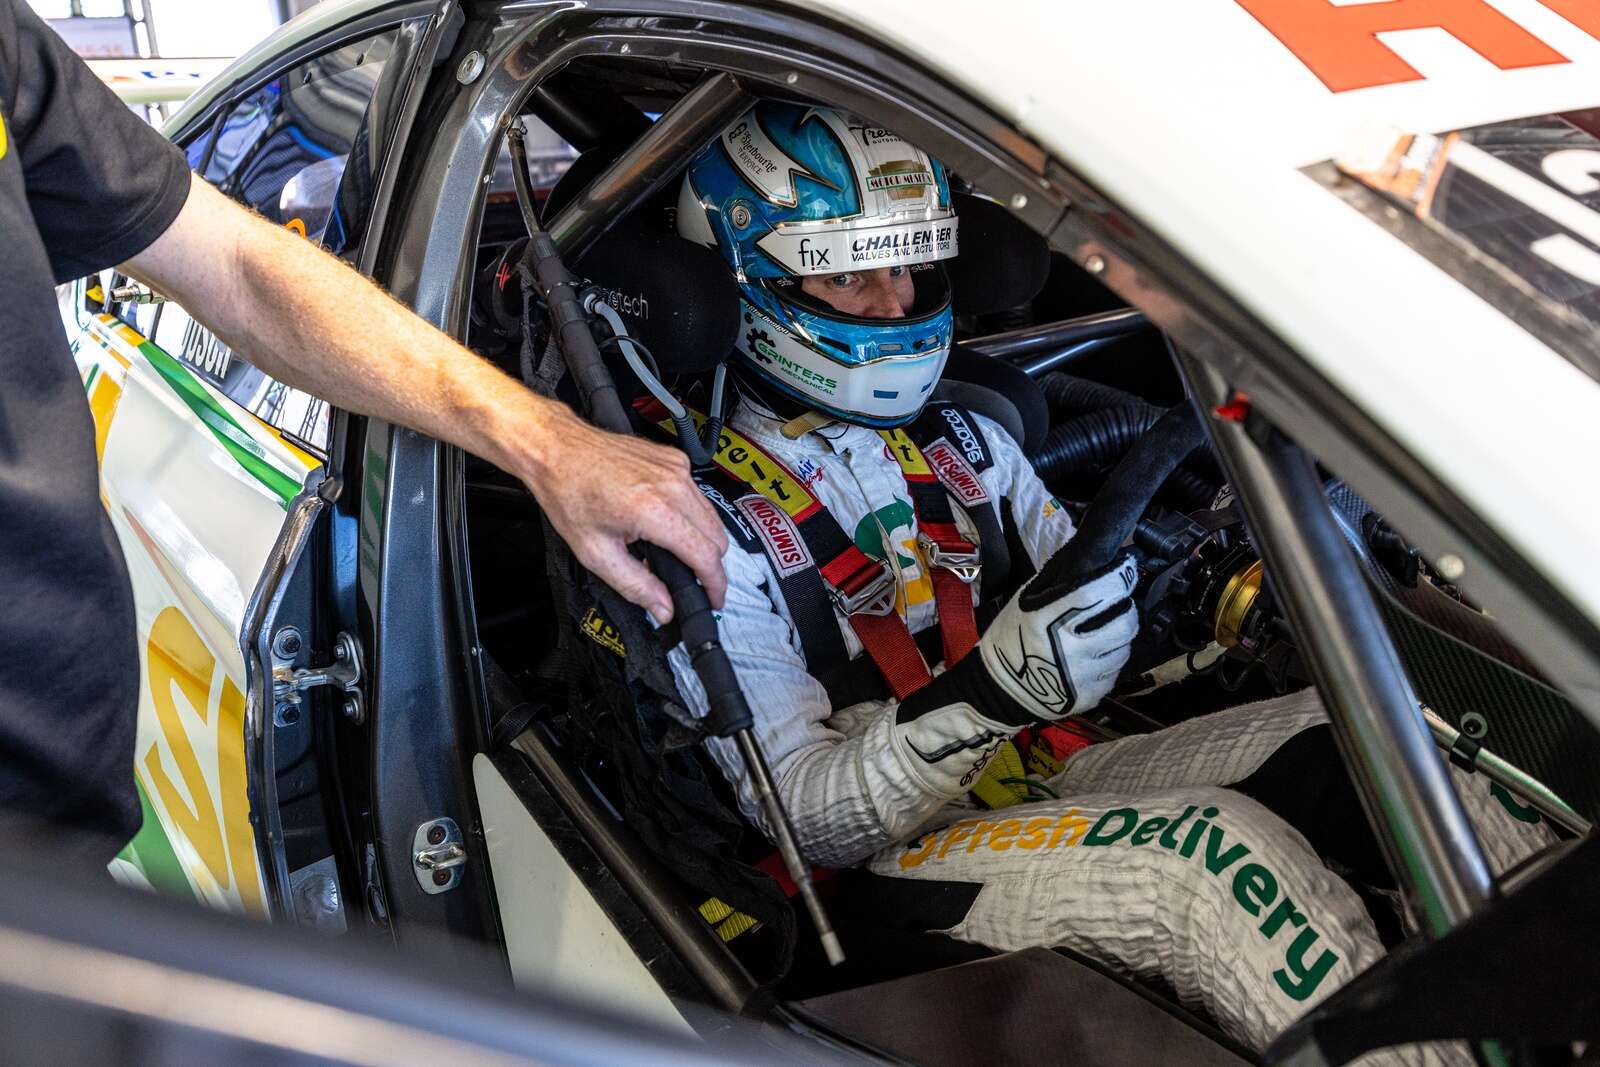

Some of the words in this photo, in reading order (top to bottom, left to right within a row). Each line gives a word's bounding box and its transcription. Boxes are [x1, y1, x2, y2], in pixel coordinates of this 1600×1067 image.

[848, 126, 897, 146] Tre
[870, 175, 902, 189] MOTOR
[798, 238, 831, 270] fix
[852, 227, 952, 252] CHALLENGER
[851, 248, 890, 263] VALVES
[893, 245, 911, 257] AND
[913, 240, 950, 255] ACTUTORS
[757, 341, 837, 389] GRINTERS
[780, 366, 836, 396] MECHANICAL
[940, 408, 985, 464] sparco
[931, 447, 981, 499] SIMPSON
[750, 499, 802, 564] SIMPSON
